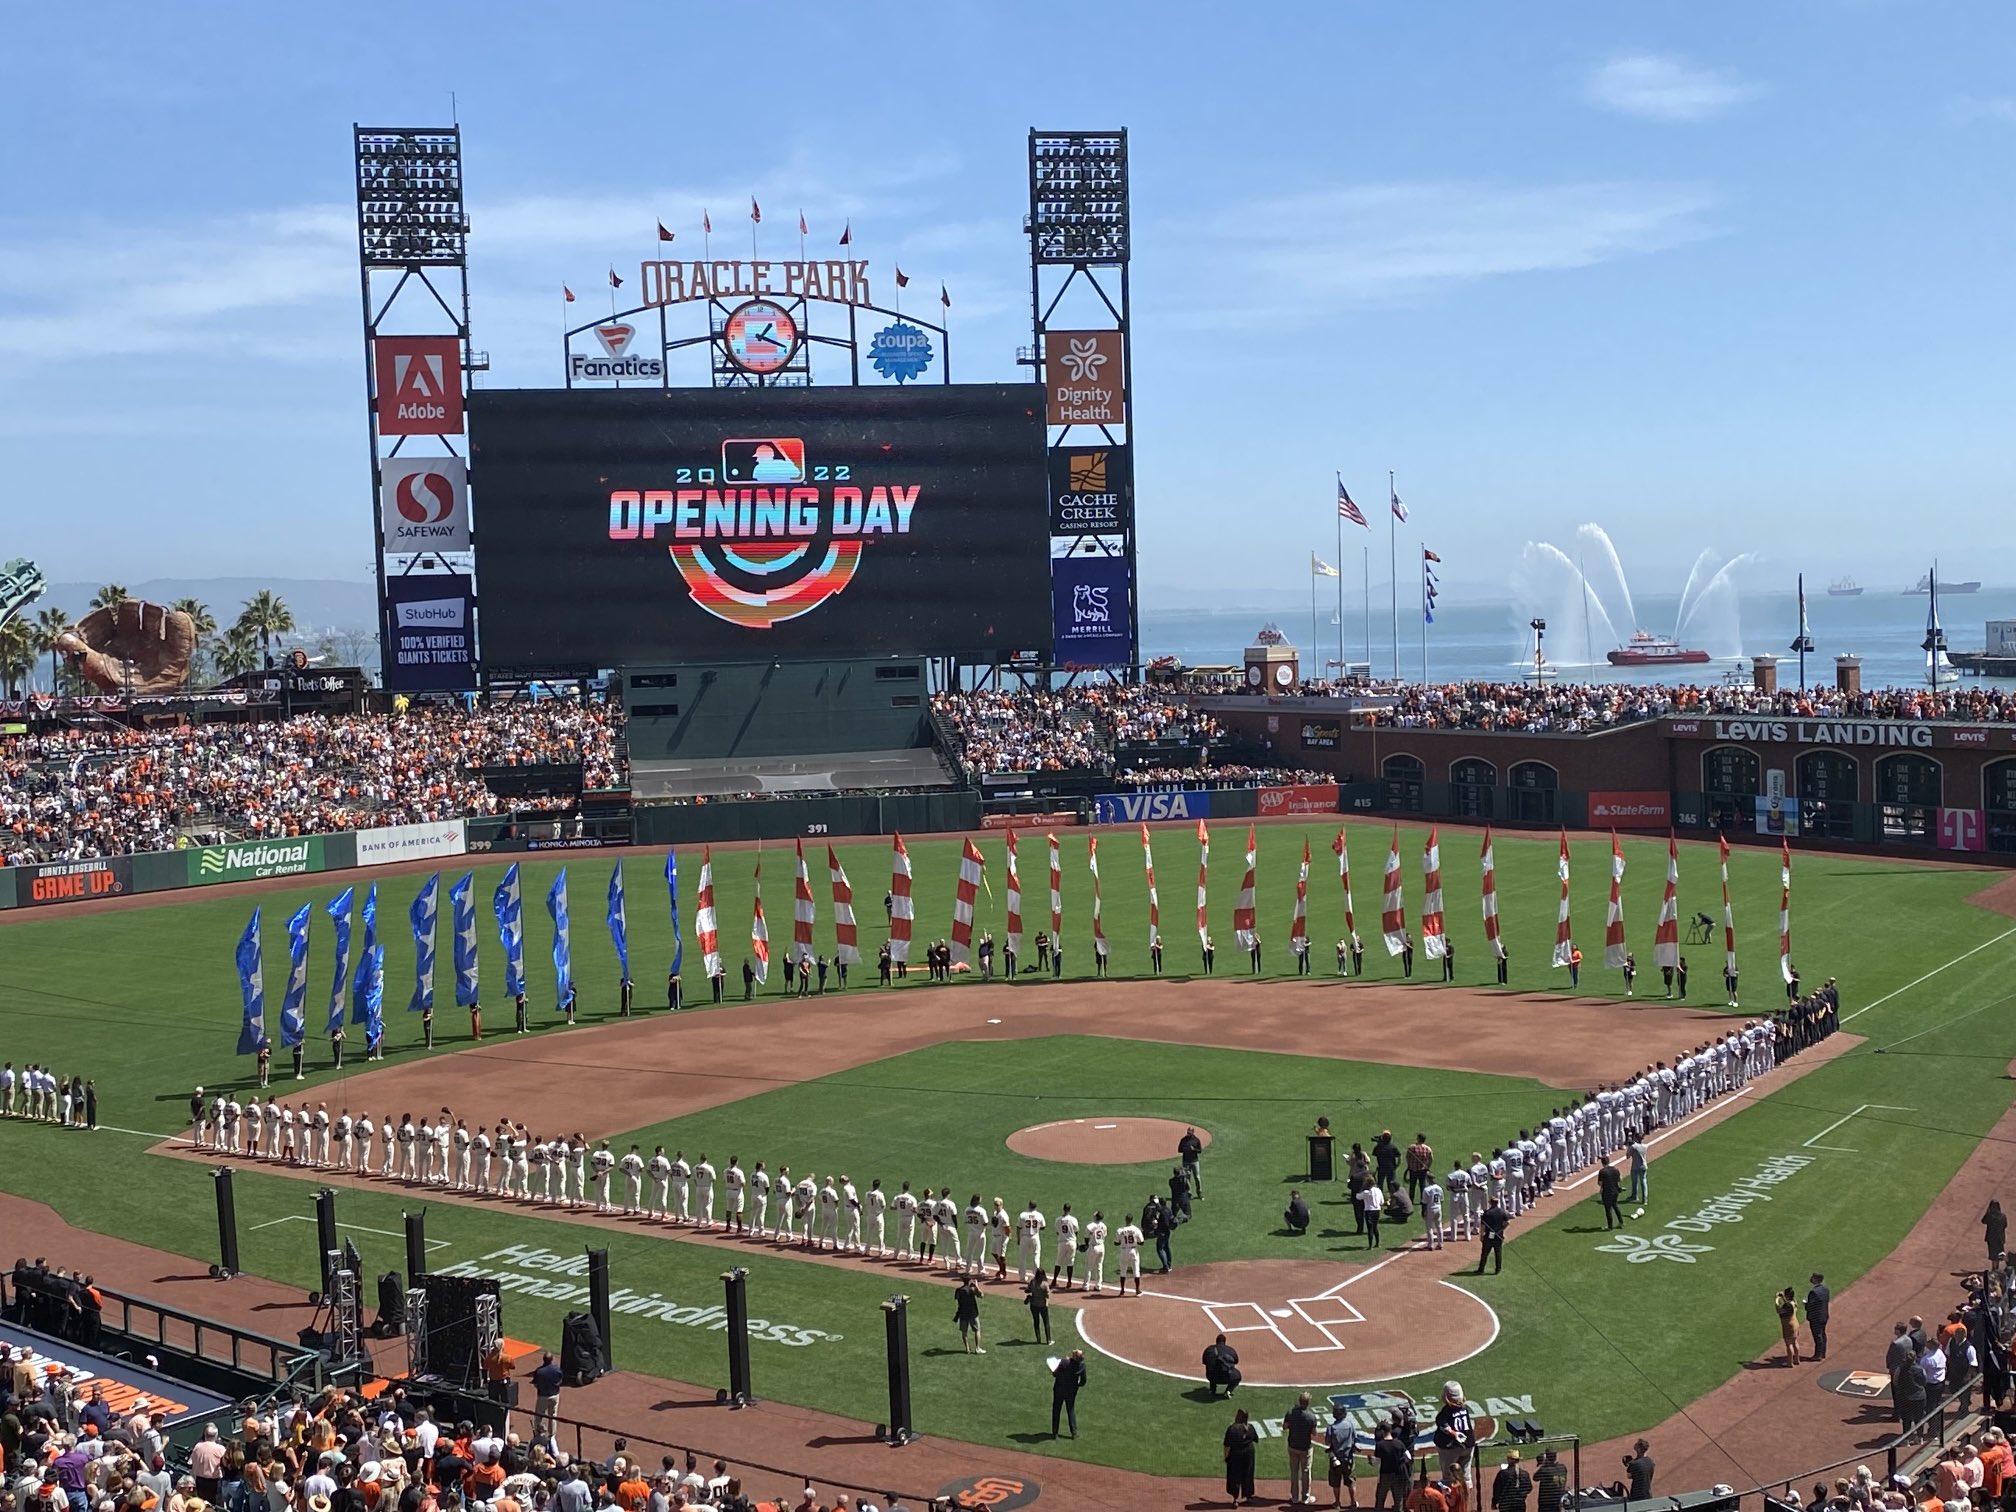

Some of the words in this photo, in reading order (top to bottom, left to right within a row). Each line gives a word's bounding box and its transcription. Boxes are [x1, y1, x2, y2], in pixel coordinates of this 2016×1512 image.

[641, 261, 771, 308] ORACLE
[783, 260, 872, 308] PARK
[877, 333, 927, 352] coupa
[572, 357, 661, 377] Fanatics
[1057, 387, 1112, 405] Dignity
[397, 403, 445, 419] Adobe
[1060, 405, 1111, 420] Health
[676, 468, 715, 483] 20
[814, 466, 850, 481] 22
[1059, 494, 1118, 506] CACHE
[608, 487, 820, 540] OPENING
[831, 485, 921, 535] DAY
[1061, 507, 1117, 519] CREEK
[397, 526, 455, 537] SAFEWAY
[1059, 521, 1088, 529] CASINO
[1090, 520, 1119, 528] RESORT
[405, 608, 456, 620] StubHub
[1071, 625, 1113, 634] MERRILL
[400, 637, 424, 649] 100%
[426, 635, 465, 649] VERIFIED
[398, 651, 430, 665] GIANTS
[432, 650, 468, 664] TICKETS
[319, 676, 345, 692] Coffee
[1312, 725, 1340, 738] Sports
[1797, 723, 1933, 747] LANDING
[1318, 738, 1334, 746] AREA
[1136, 784, 1185, 793] WELCOME
[1195, 783, 1207, 791] TO
[1117, 794, 1189, 822] VISA
[1288, 799, 1337, 810] Insurance
[1354, 798, 1371, 808] 415
[1678, 813, 1697, 824] 365
[807, 823, 828, 834] 391
[362, 843, 386, 852] BANK
[388, 841, 400, 849] OF
[401, 836, 441, 848] AMERICA
[469, 841, 492, 851] 399
[538, 840, 568, 849] KONICA
[569, 839, 602, 847] MINOLTA
[226, 841, 309, 869] National
[38, 864, 67, 878] GIANTS
[68, 862, 108, 874] BASEBALL
[255, 866, 274, 877] Car
[275, 862, 306, 875] Rental
[32, 873, 85, 900] GAME
[90, 871, 115, 894] UP
[1664, 1188, 1773, 1233] Dignity
[1731, 1154, 1817, 1190] Health
[479, 1243, 592, 1277] Hello
[1453, 1415, 1470, 1432] 01
